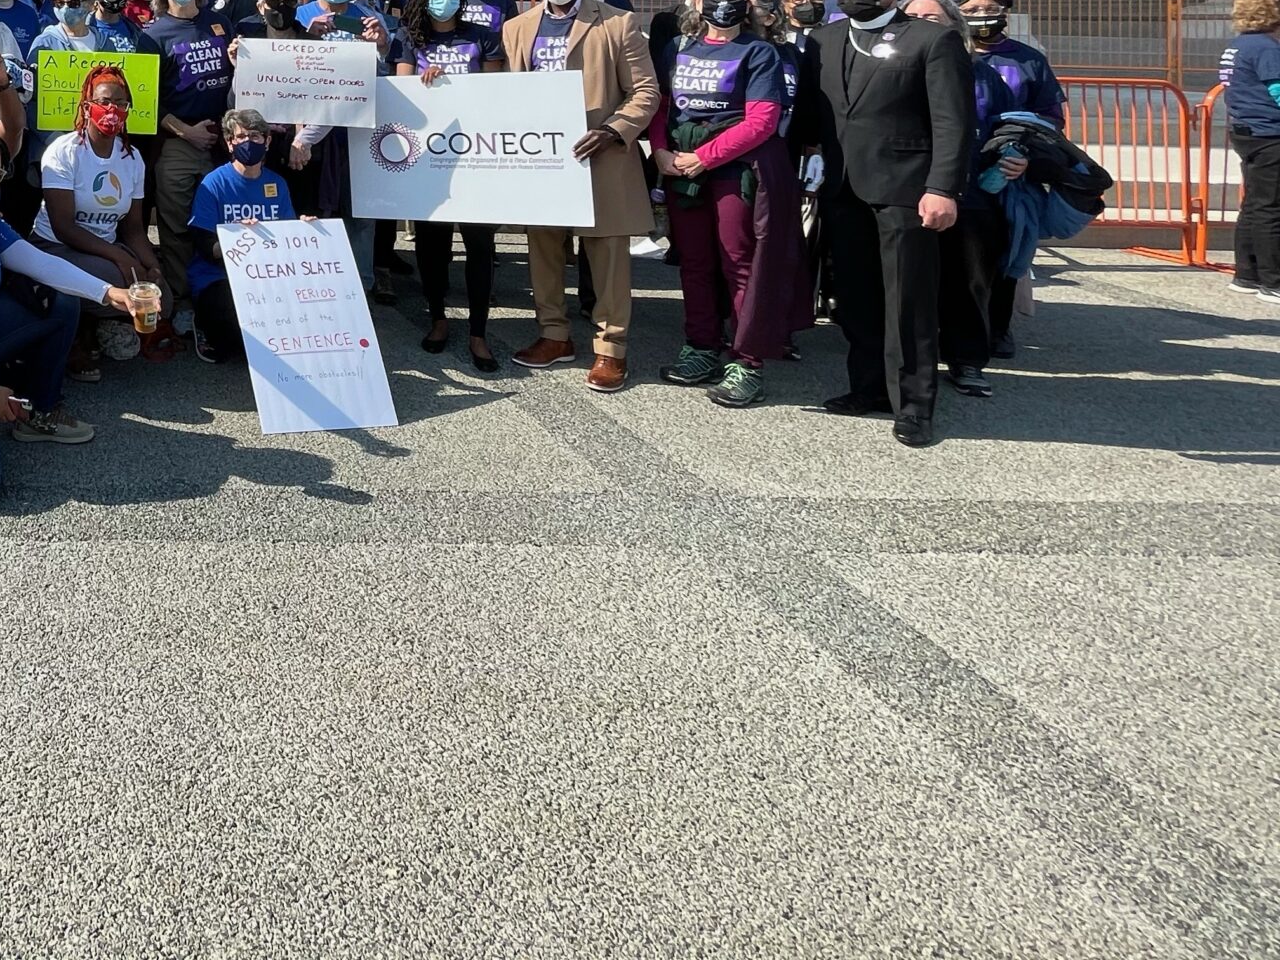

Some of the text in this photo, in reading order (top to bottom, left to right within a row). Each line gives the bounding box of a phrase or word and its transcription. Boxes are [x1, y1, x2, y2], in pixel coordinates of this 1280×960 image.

[190, 40, 211, 50] PASS
[272, 42, 315, 53] LOCKED
[185, 47, 222, 63] CLEAN
[426, 52, 470, 63] CLEAN
[536, 48, 566, 60] CLEA
[44, 54, 128, 71] A Record
[190, 59, 222, 74] SLATE
[539, 60, 566, 71] SLAT
[689, 59, 718, 69] PASS
[676, 64, 725, 79] CLEAN
[42, 73, 80, 89] Shoul
[206, 76, 228, 87] COECT
[257, 74, 301, 83] UNLOCK
[339, 79, 365, 87] DOORS
[674, 77, 718, 92] SLATE
[277, 91, 308, 100] SUPPORT
[42, 96, 77, 116] Lifet
[689, 99, 729, 109] CONECT
[426, 132, 565, 155] CONECT
[223, 204, 280, 220] PEOPLE
[225, 232, 319, 267] PASS SB 1019
[246, 261, 344, 279] CLEAN SLATE
[246, 292, 266, 305] Put
[295, 288, 337, 300] PERIOD
[345, 291, 357, 300] at
[250, 313, 334, 328] the end of the
[277, 372, 288, 383] No
